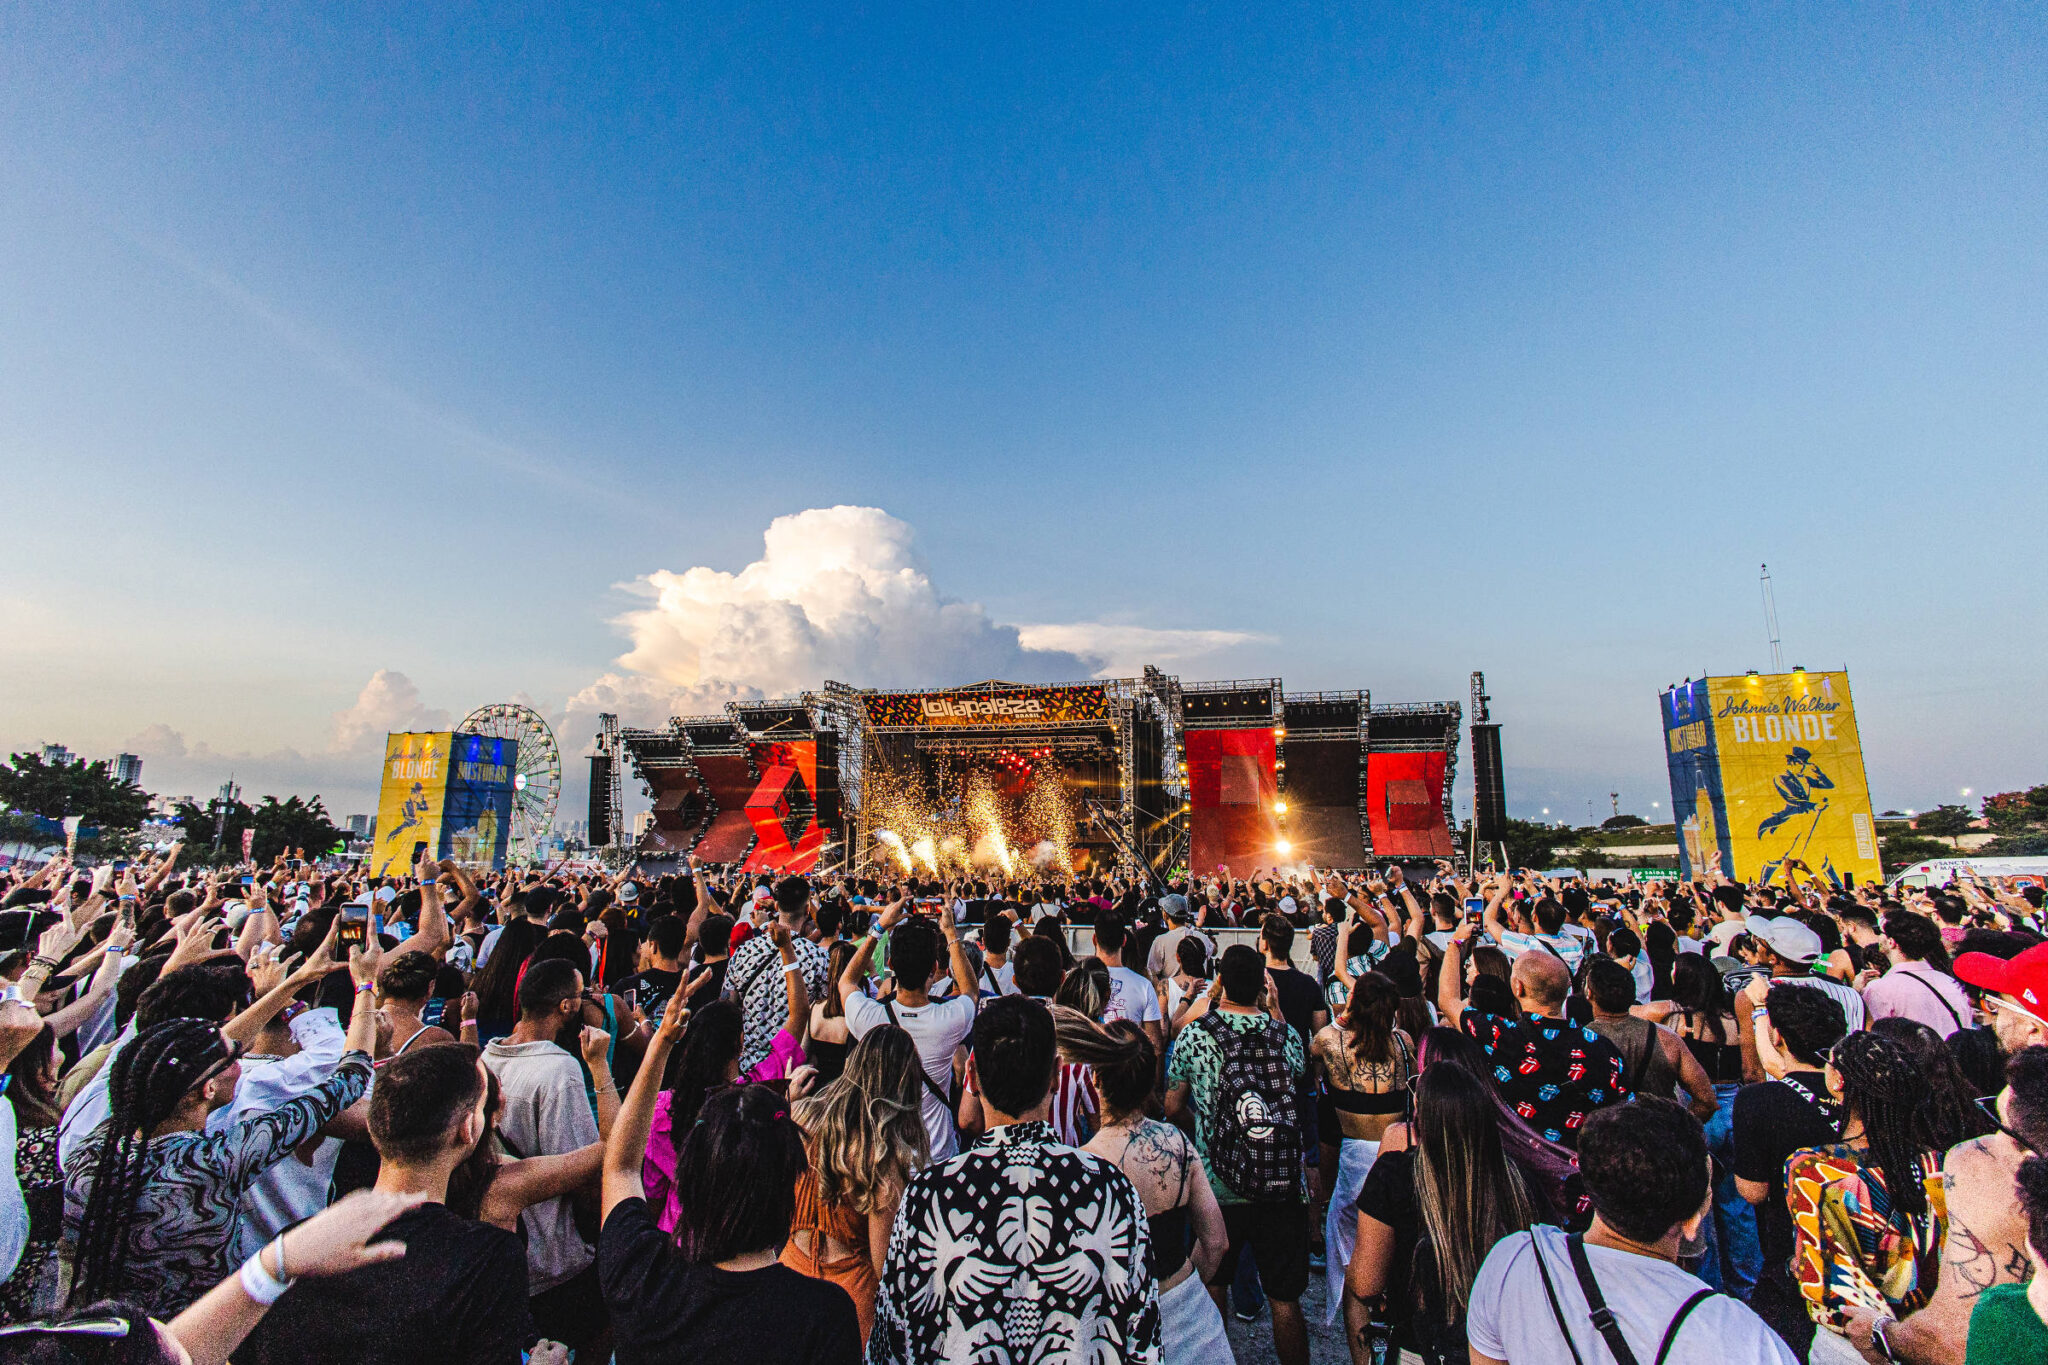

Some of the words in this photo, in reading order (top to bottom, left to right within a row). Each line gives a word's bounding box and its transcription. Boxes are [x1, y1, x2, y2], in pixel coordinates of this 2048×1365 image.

[920, 698, 1044, 718] Lollapalooza
[1718, 696, 1780, 718] Johnnie
[1782, 694, 1840, 714] Walker
[1733, 713, 1838, 743] BLONDE
[392, 760, 439, 779] BLONDE
